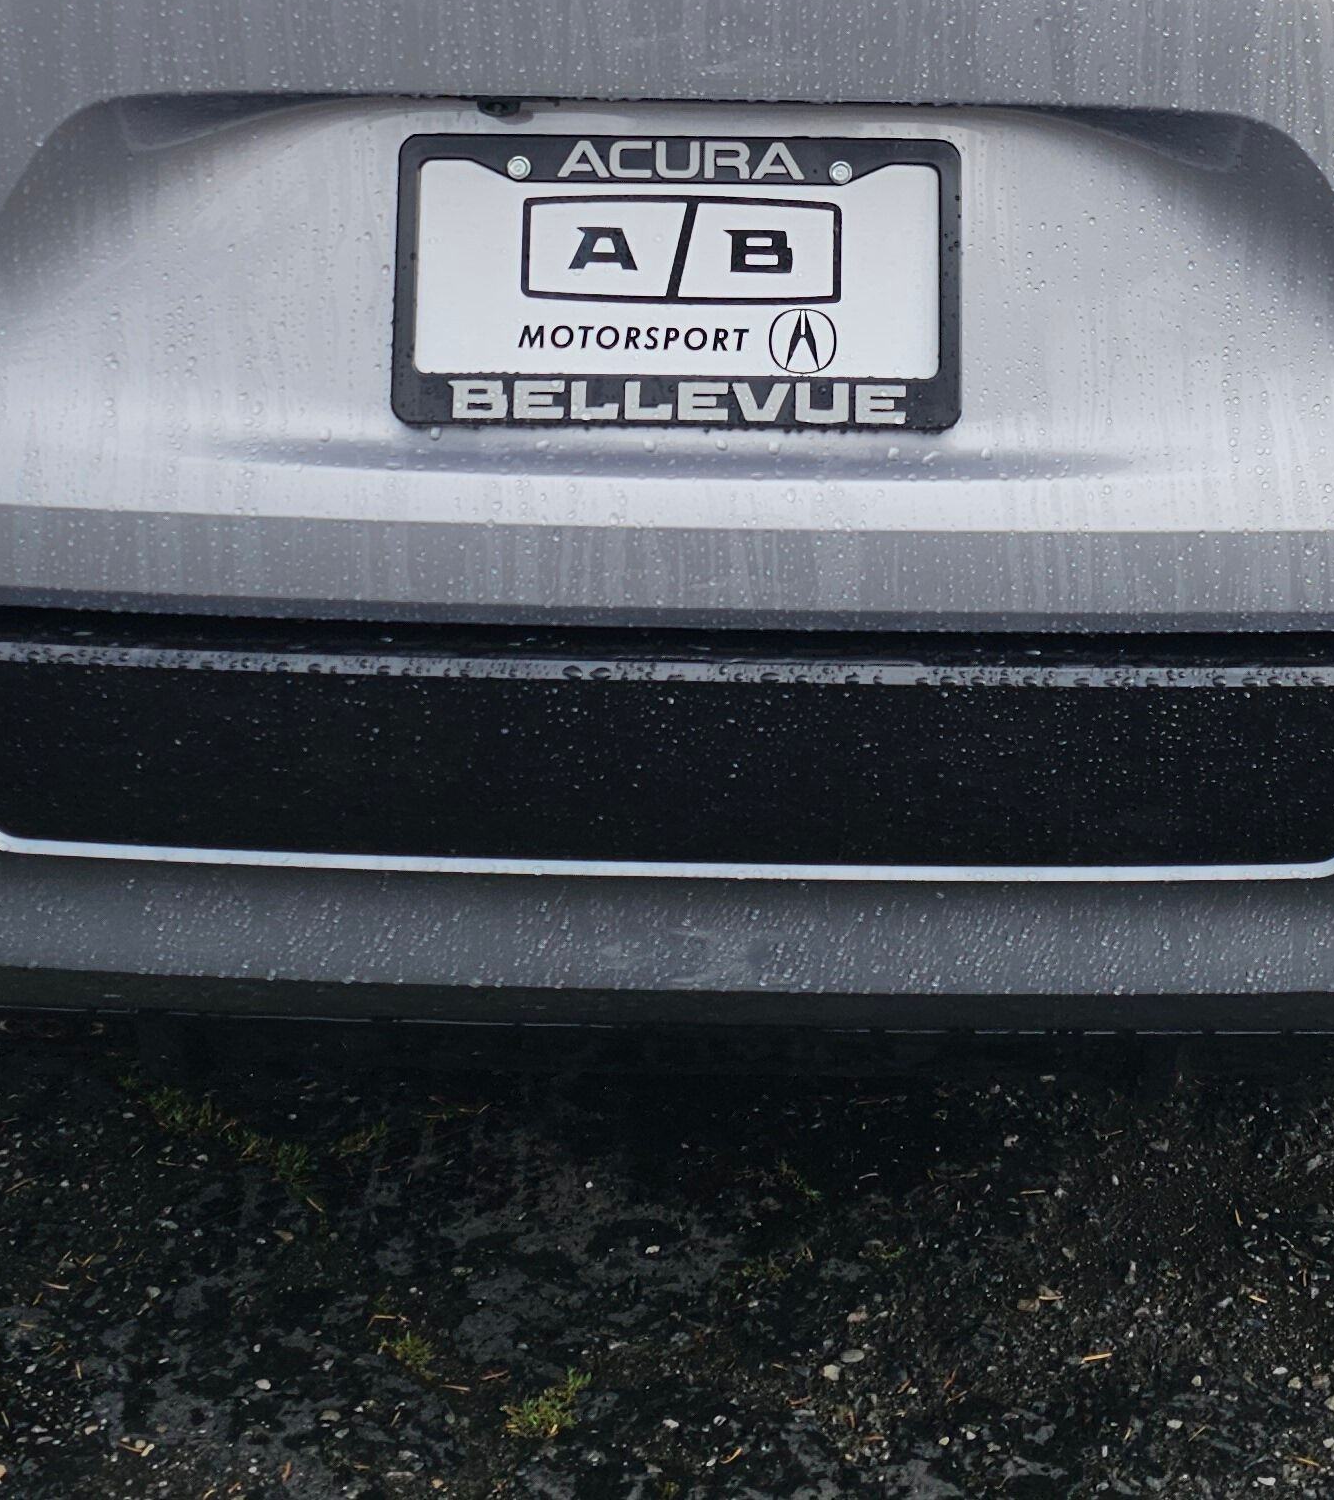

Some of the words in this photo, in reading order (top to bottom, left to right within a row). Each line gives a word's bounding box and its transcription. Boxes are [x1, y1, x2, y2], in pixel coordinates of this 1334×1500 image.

[557, 140, 805, 181] ACURA
[517, 324, 750, 353] MOTORSPORT
[447, 379, 908, 426] BELLEVUE
